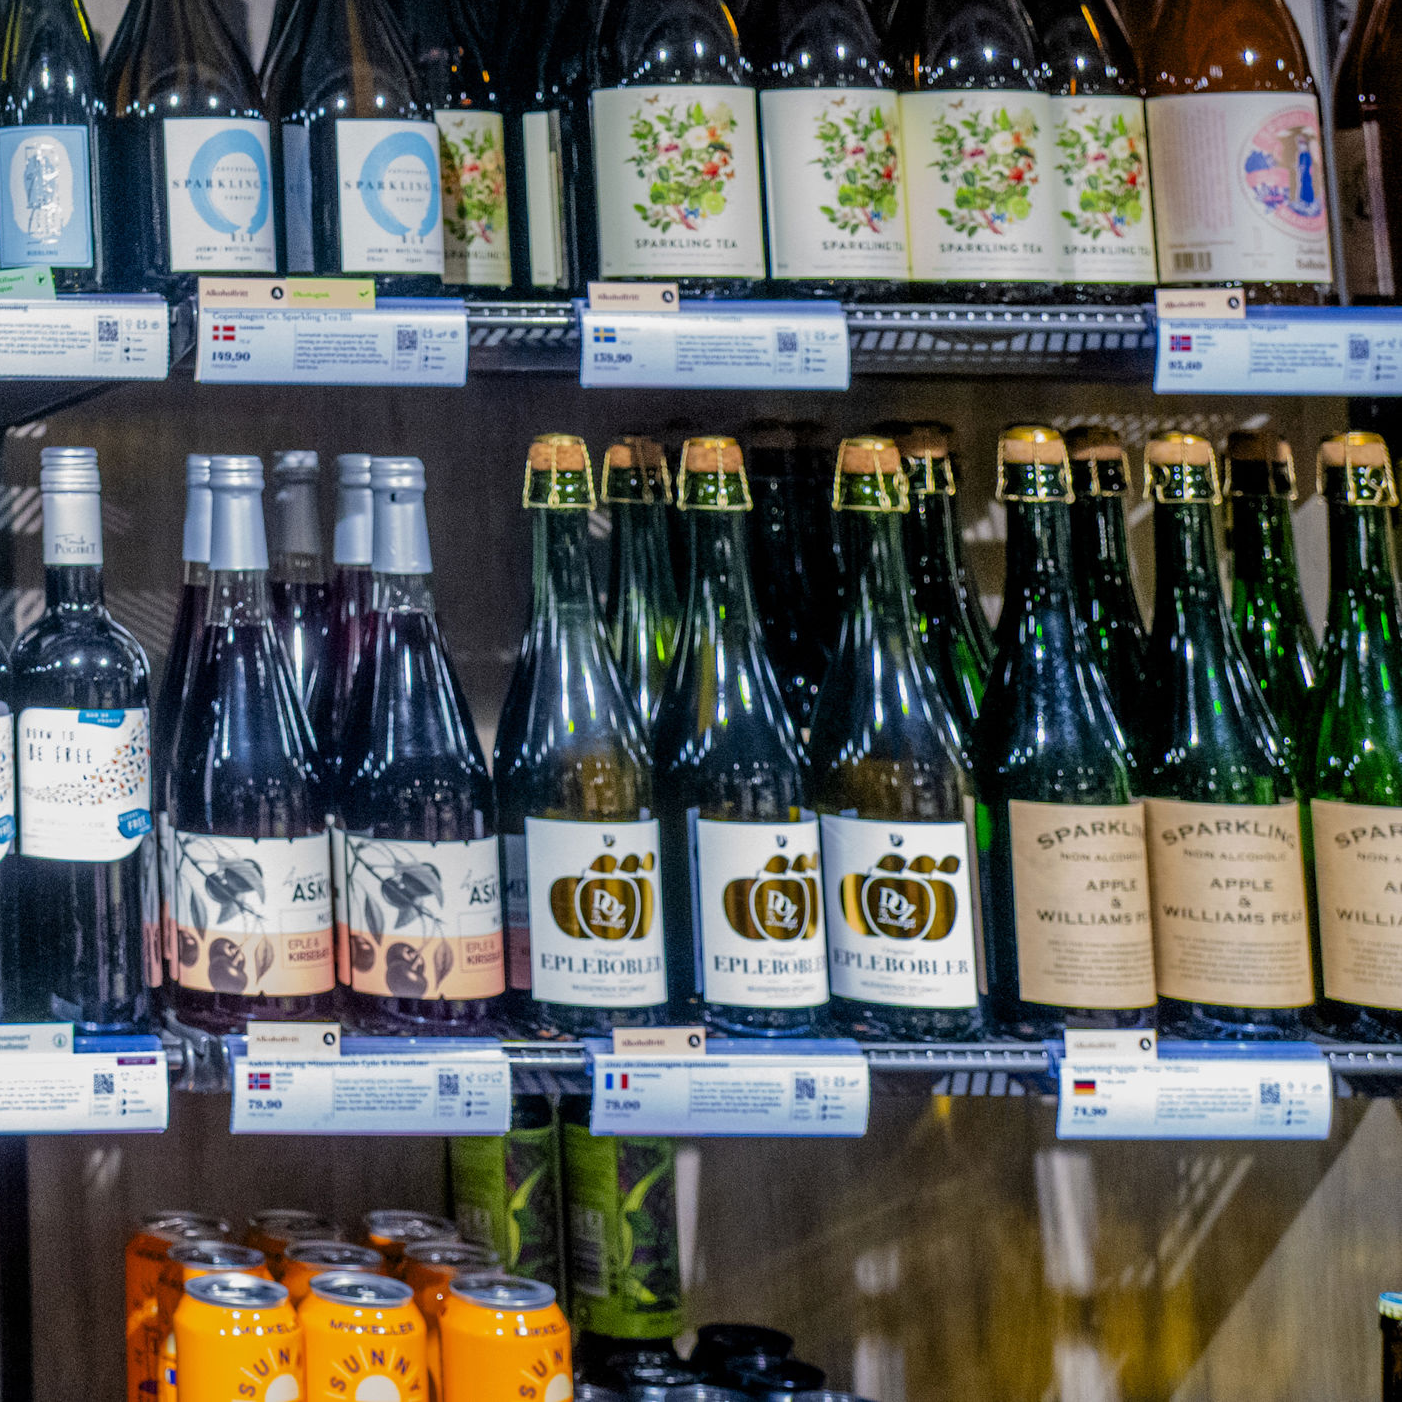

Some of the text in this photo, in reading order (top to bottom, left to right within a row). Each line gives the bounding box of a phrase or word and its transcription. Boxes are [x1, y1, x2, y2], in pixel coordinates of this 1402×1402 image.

[634, 238, 738, 249] SPARKLING TEA
[939, 242, 1043, 255] SPARKLING TEA
[1062, 245, 1134, 257] SPARKLING
[205, 290, 248, 298] Alkoholfritt
[212, 312, 265, 322] Copenhagen
[282, 312, 322, 323] Sparkling
[211, 351, 251, 362] 149,90
[55, 744, 92, 764] FREE
[1161, 818, 1297, 850] SPARKLING
[1060, 850, 1090, 863] NON
[1182, 847, 1217, 862] NON
[1356, 851, 1388, 863] NON
[1086, 877, 1138, 893] APPLE
[1209, 877, 1274, 893] APPLE
[1110, 897, 1122, 910] &
[1238, 896, 1253, 909] &
[1035, 908, 1133, 927] WILLIAMS
[1162, 904, 1265, 926] WILLIAMS
[287, 938, 311, 949] EPLE
[833, 949, 970, 975] EPLEBOBLER
